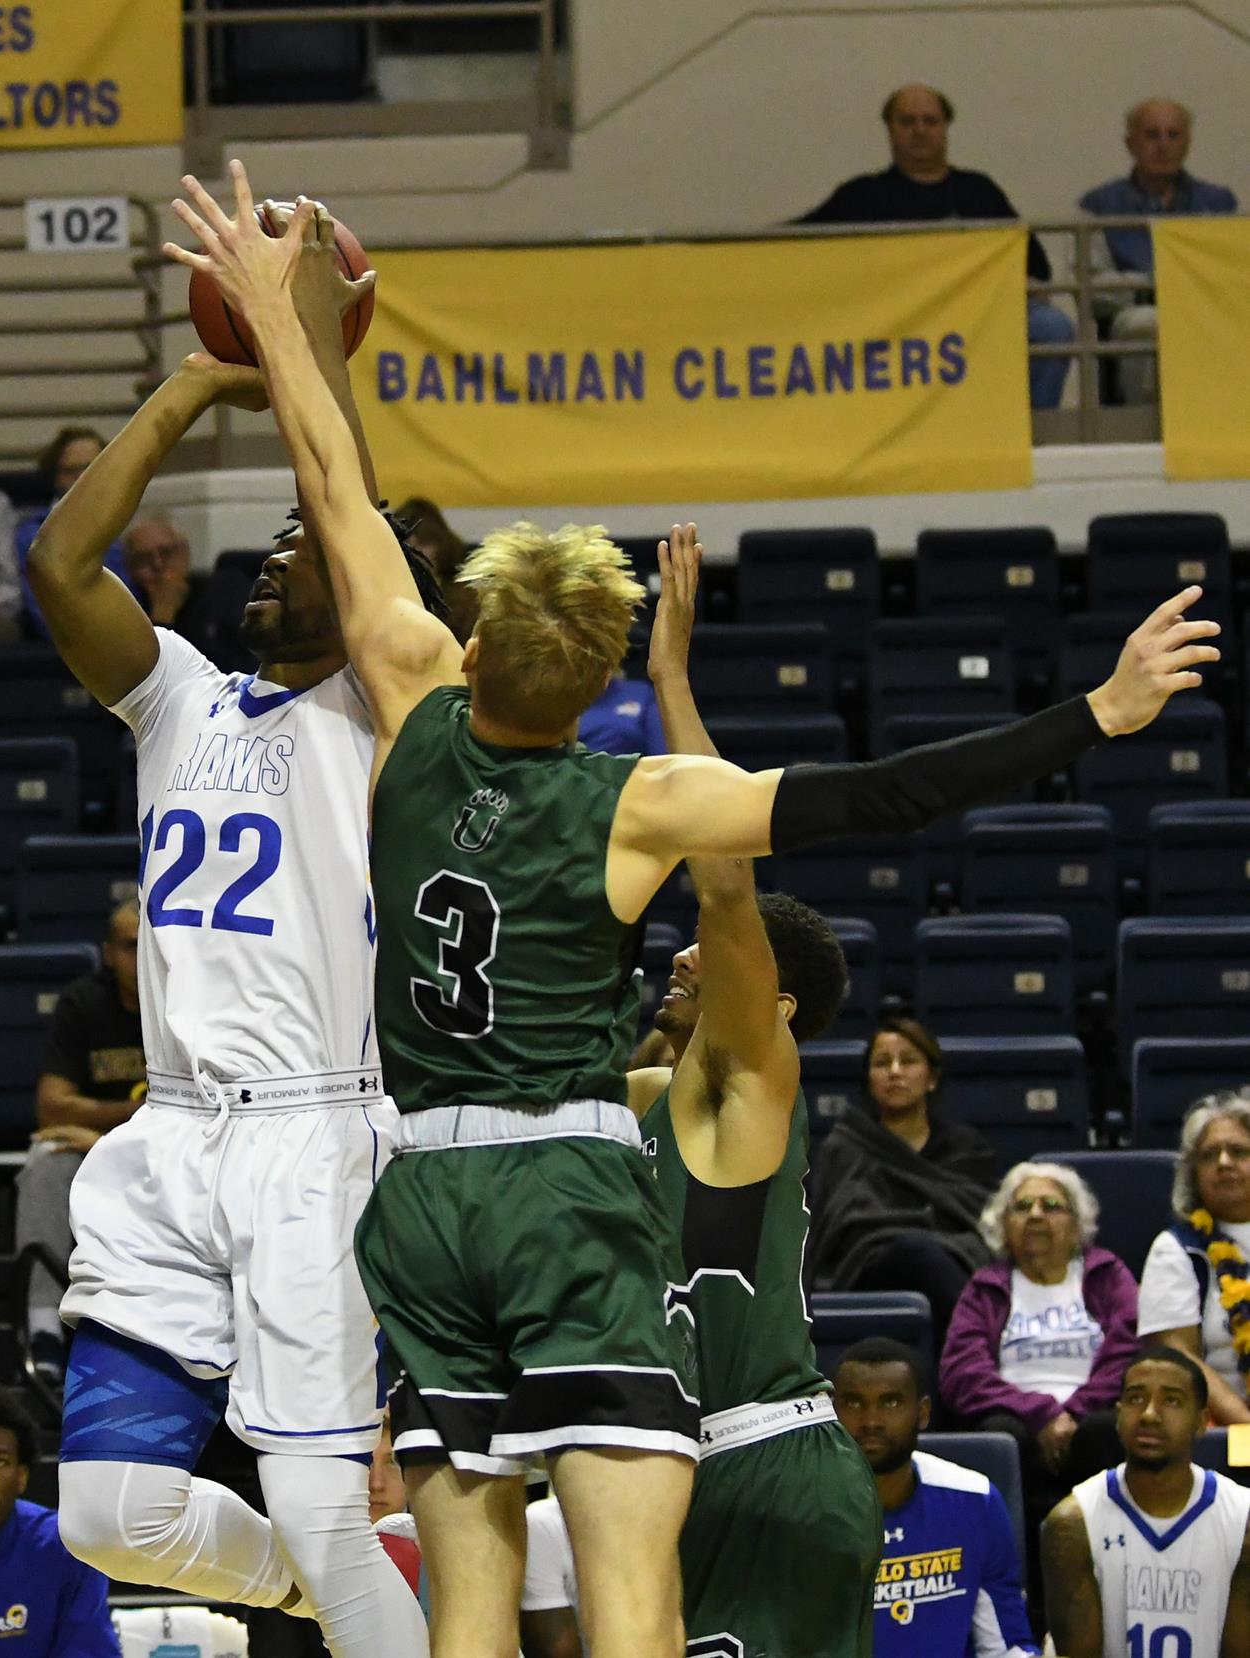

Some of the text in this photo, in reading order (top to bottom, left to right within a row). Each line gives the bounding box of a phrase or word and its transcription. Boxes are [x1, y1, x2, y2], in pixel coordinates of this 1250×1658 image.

[38, 206, 119, 244] 102
[376, 331, 967, 404] BAHLMAN CLEANERS
[146, 808, 282, 937] 22
[409, 868, 502, 1040] 3
[257, 1081, 355, 1101] UNDER ARMOUR
[909, 1553, 962, 1579] STATE
[874, 1573, 957, 1602] KETBALL
